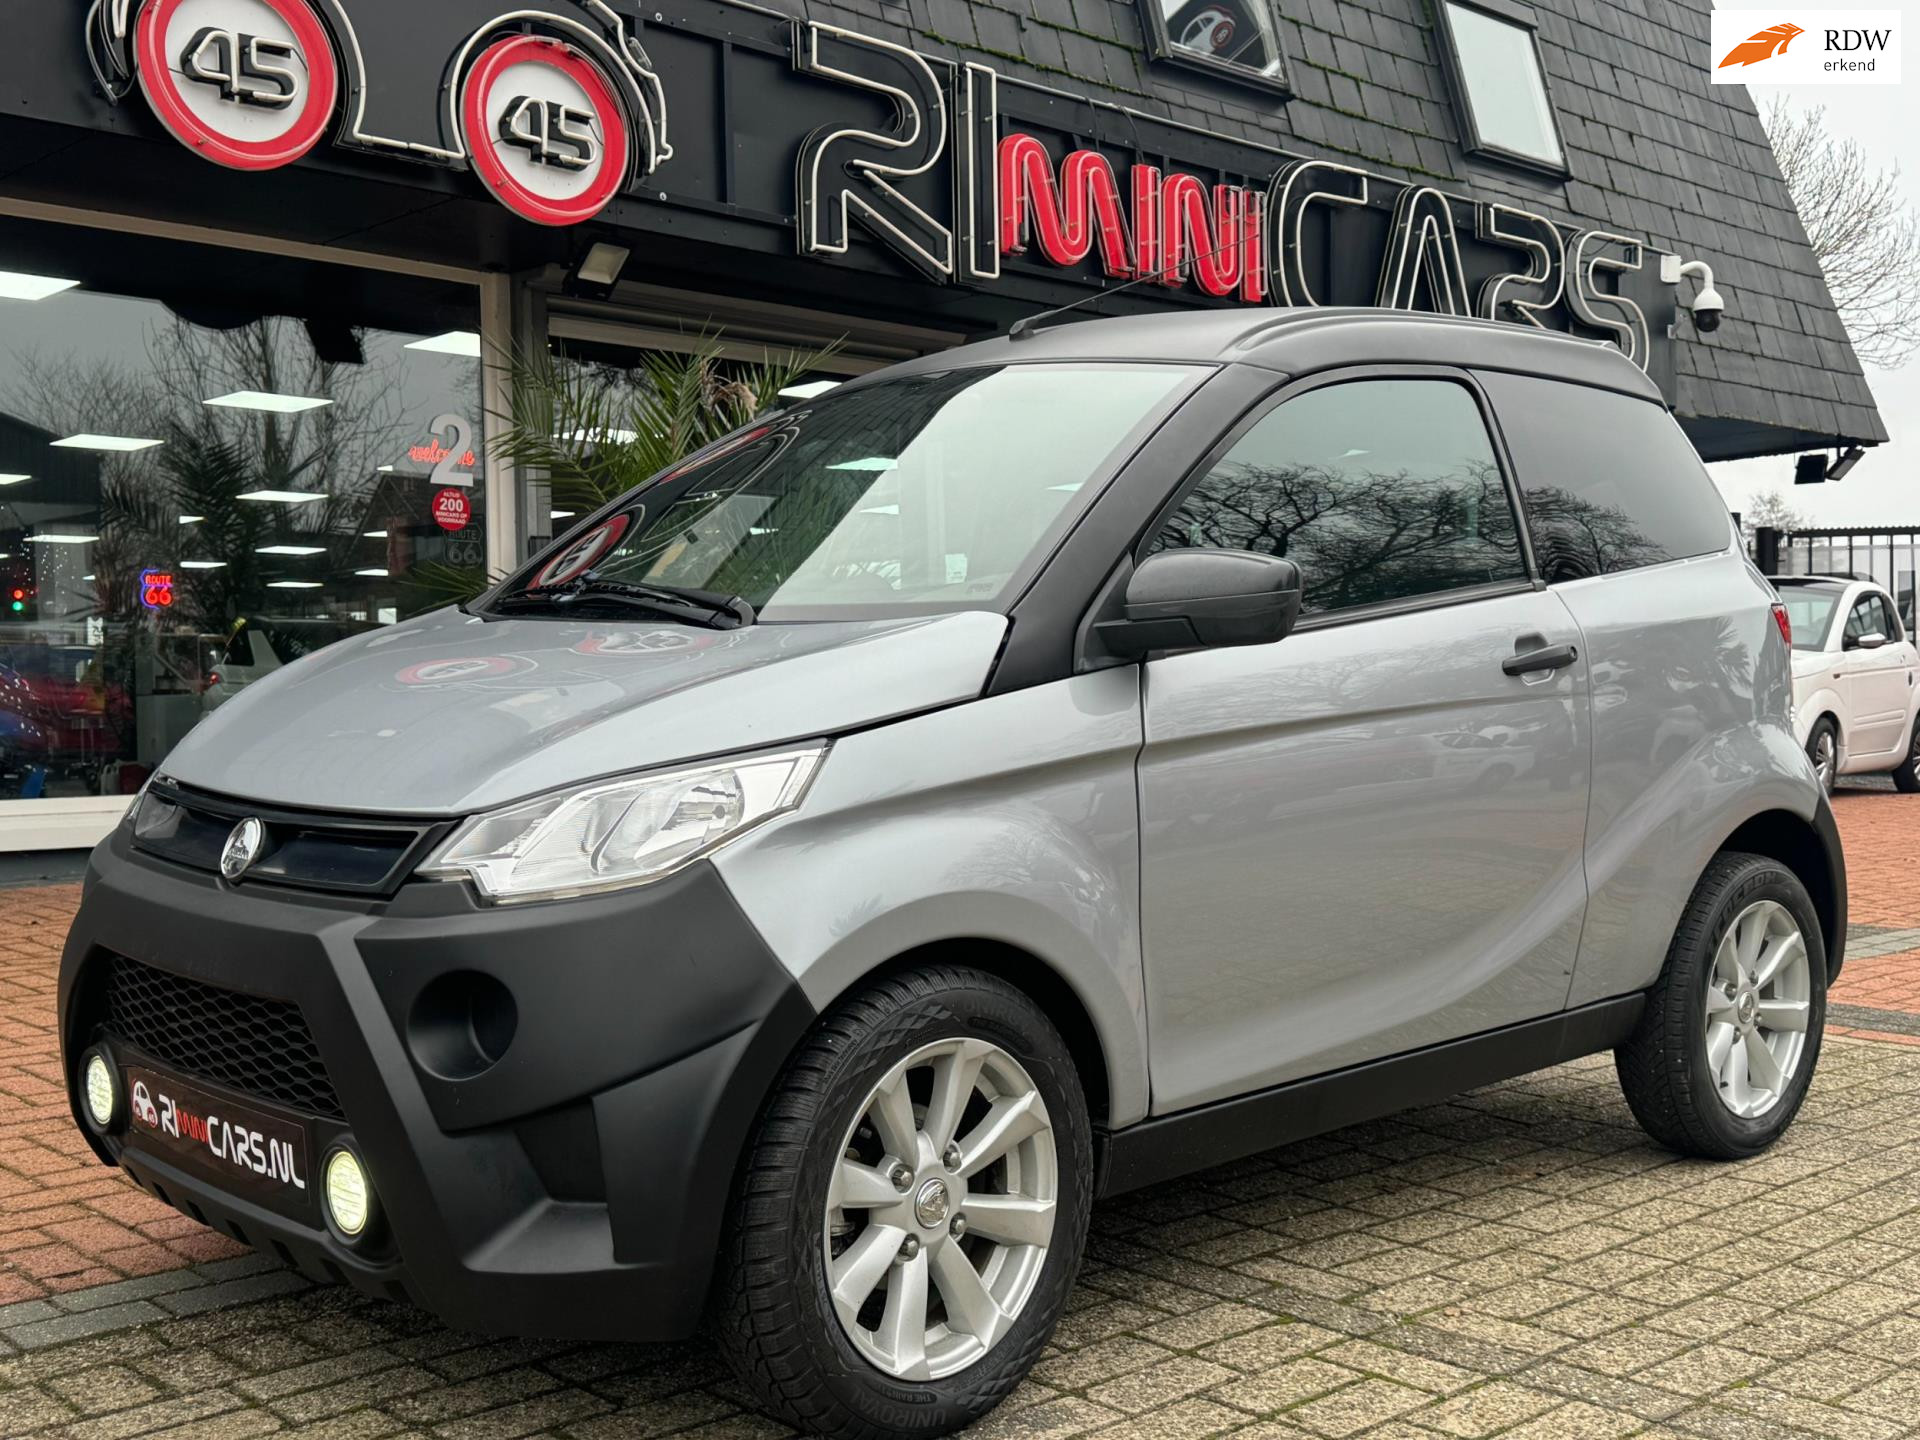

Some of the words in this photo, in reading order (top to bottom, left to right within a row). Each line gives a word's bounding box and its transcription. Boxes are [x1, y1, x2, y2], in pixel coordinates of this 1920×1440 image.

[180, 26, 298, 110] 45
[499, 95, 598, 172] 45
[408, 438, 476, 466] welce
[429, 413, 474, 487] 2
[440, 497, 464, 512] 200
[449, 542, 477, 564] 66
[145, 575, 172, 585] ROUTE
[145, 586, 172, 605] 66
[848, 1383, 947, 1429] UNIROYAL
